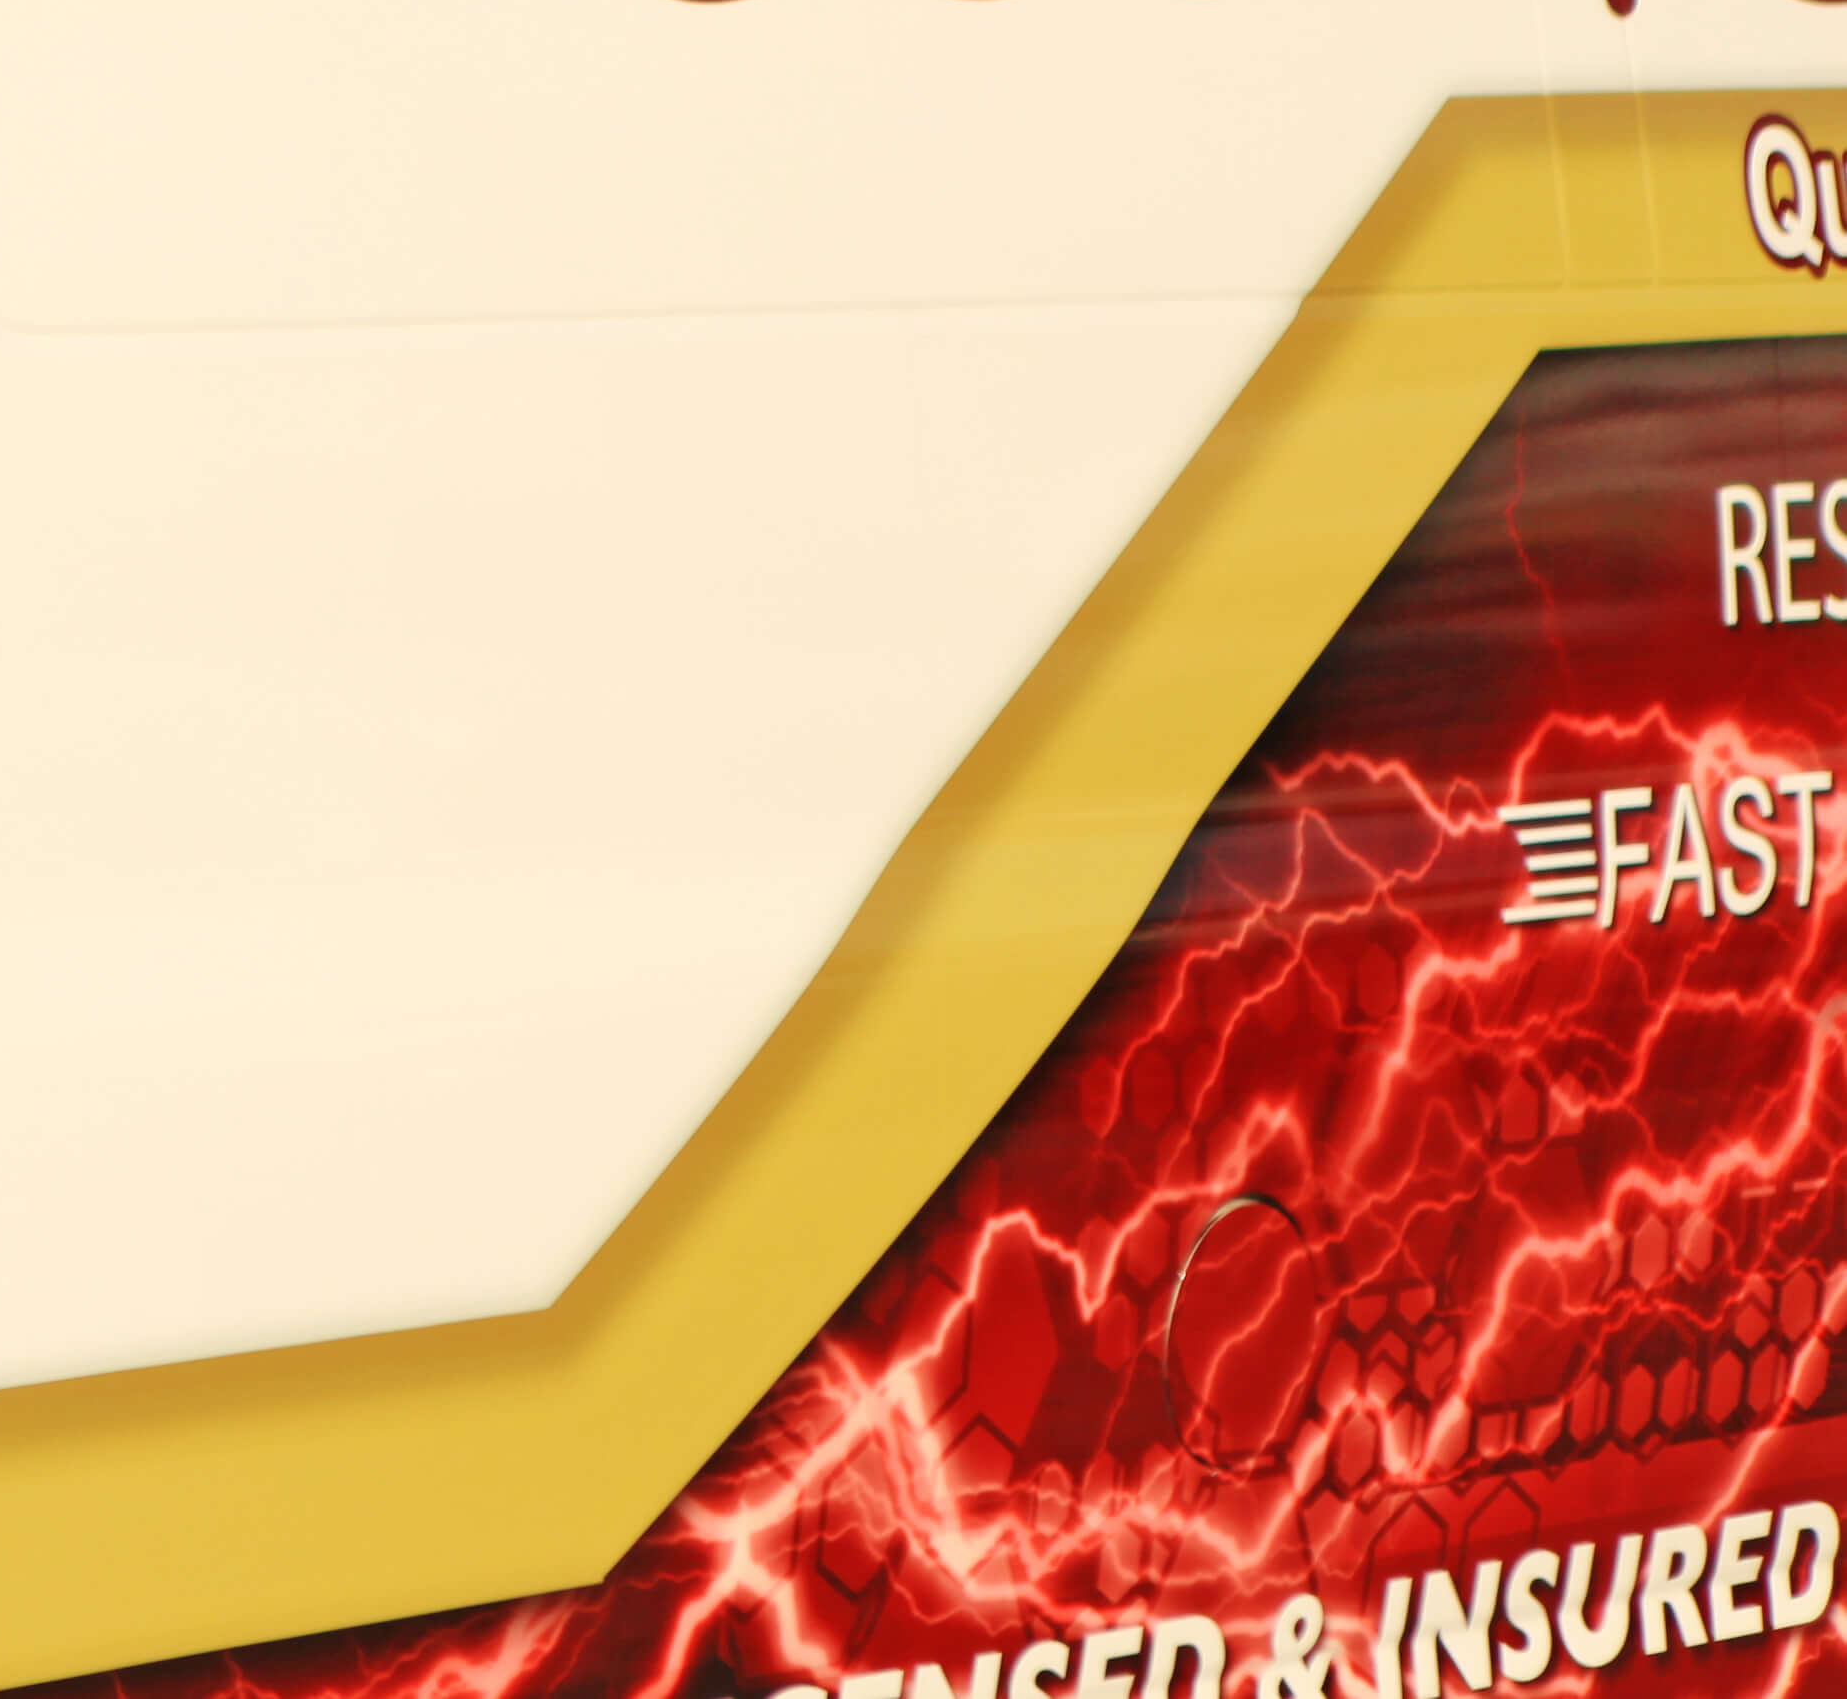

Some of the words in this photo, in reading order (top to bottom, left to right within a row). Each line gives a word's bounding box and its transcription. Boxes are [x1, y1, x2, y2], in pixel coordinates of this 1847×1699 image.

[1596, 770, 1834, 929] FAST
[1268, 1592, 1342, 1699] &
[1376, 1500, 1841, 1698] INSURED
